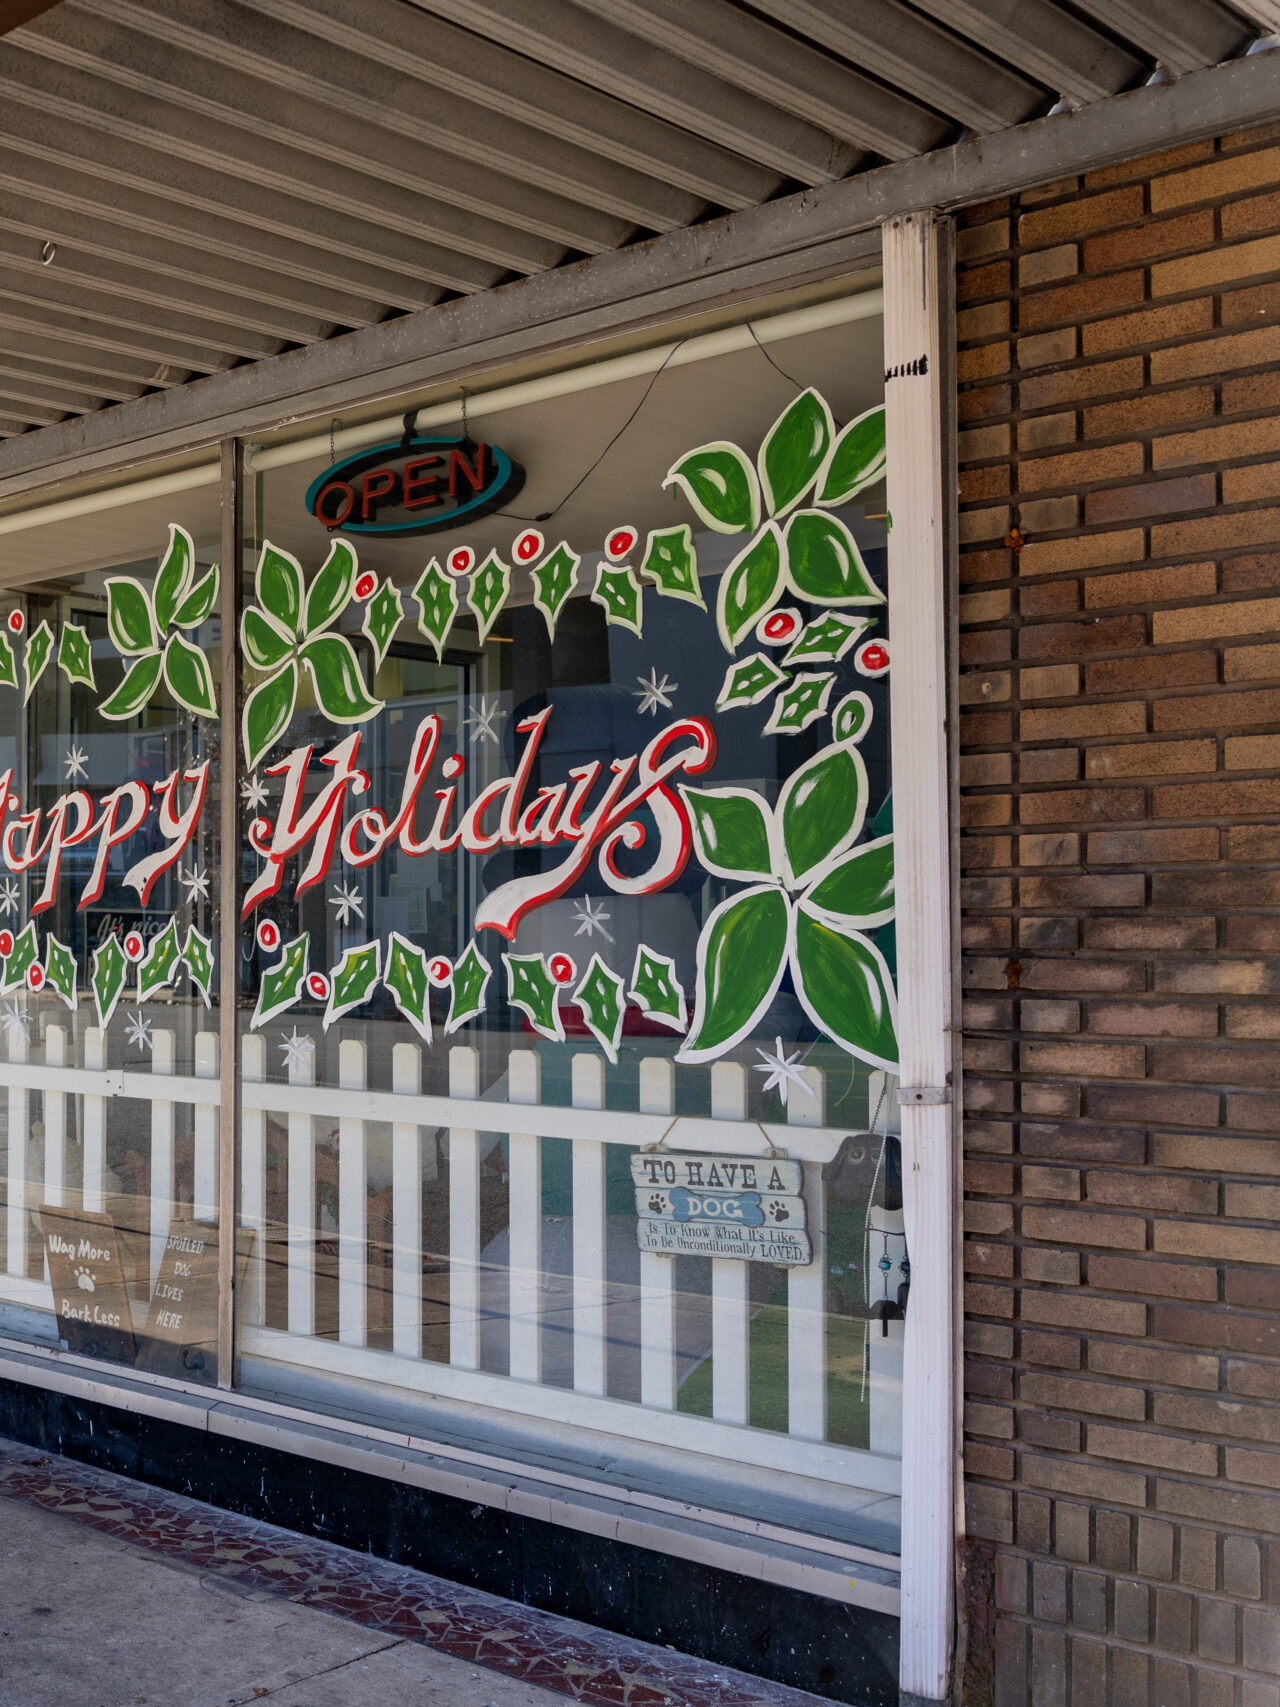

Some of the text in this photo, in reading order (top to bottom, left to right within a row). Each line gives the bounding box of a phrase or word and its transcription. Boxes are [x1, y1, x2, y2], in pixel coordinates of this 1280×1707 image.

[315, 442, 485, 527] OPEN
[238, 704, 718, 942] Holidays
[644, 1159, 786, 1190] TO HAVE A
[687, 1196, 744, 1218] DOG
[167, 1235, 204, 1254] SPOILED
[648, 1221, 795, 1244] Is To Know What It's Like
[48, 1234, 111, 1262] Wag More
[646, 1233, 806, 1262] To Be Unconditionally LOVED.
[174, 1261, 192, 1277] DOG
[155, 1282, 184, 1302] LIVES
[61, 1299, 120, 1328] Bark Less
[156, 1308, 183, 1330] HERE
